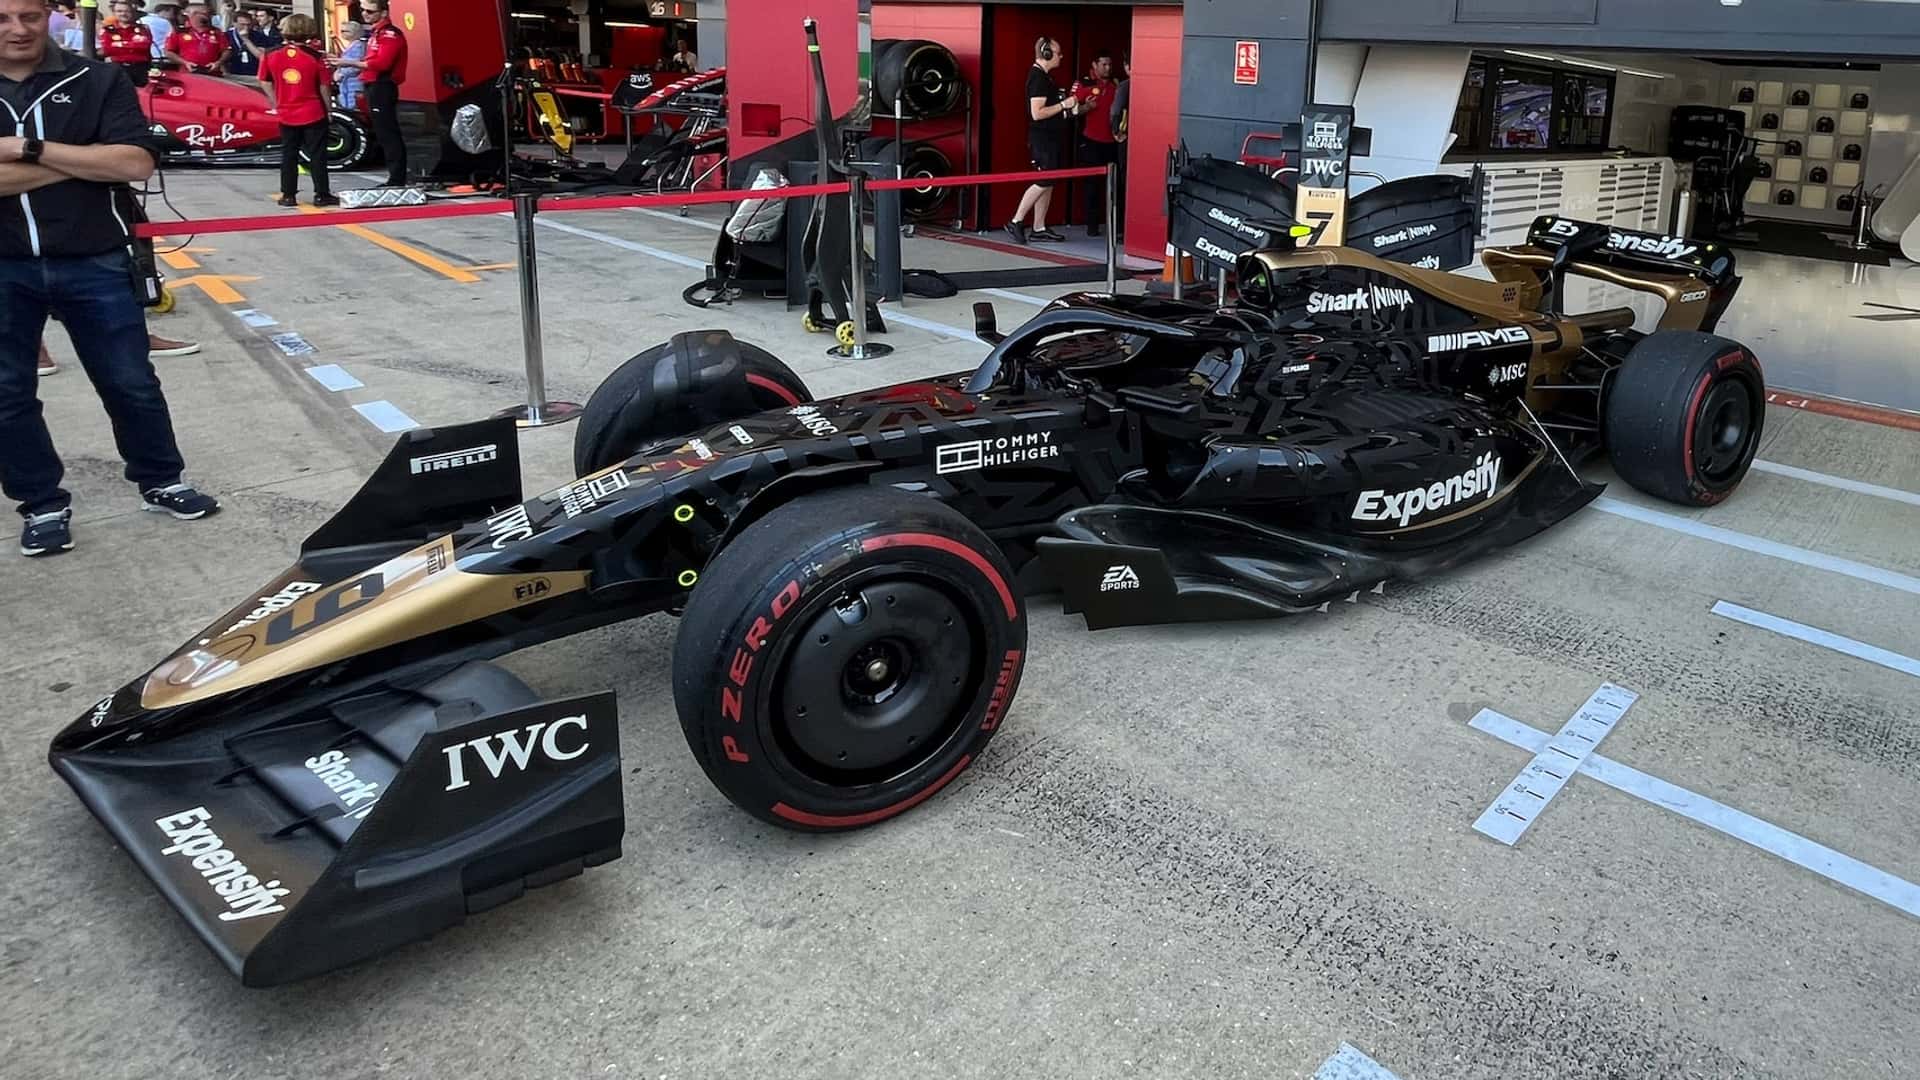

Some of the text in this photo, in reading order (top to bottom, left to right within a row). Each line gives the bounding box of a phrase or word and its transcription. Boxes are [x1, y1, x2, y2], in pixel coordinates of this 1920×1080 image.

[651, 2, 665, 15] 16
[630, 74, 651, 83] aws
[176, 123, 253, 147] Ray-Ban
[1305, 159, 1342, 175] IWC
[1208, 207, 1240, 228] Shark
[1306, 211, 1334, 246] 7
[1373, 230, 1408, 247] Shark
[1306, 285, 1413, 313] Shark NINJA
[1500, 362, 1527, 382] MSC
[800, 411, 838, 438] MSC
[983, 431, 1052, 452] TOMMY
[410, 444, 498, 474] PIRELLI
[983, 445, 1059, 467] HILFIGER
[1351, 452, 1502, 528] Expensify
[487, 504, 534, 549] IWC
[425, 544, 446, 575] PIRELLI
[1100, 579, 1140, 592] SPORTS
[1101, 564, 1139, 583] EA
[514, 579, 547, 598] FIA
[721, 580, 801, 764] P ZERO
[980, 649, 1022, 731] PIRELLI
[443, 714, 590, 792] IWC
[305, 749, 379, 808] Shark
[155, 806, 291, 921] Expensify
